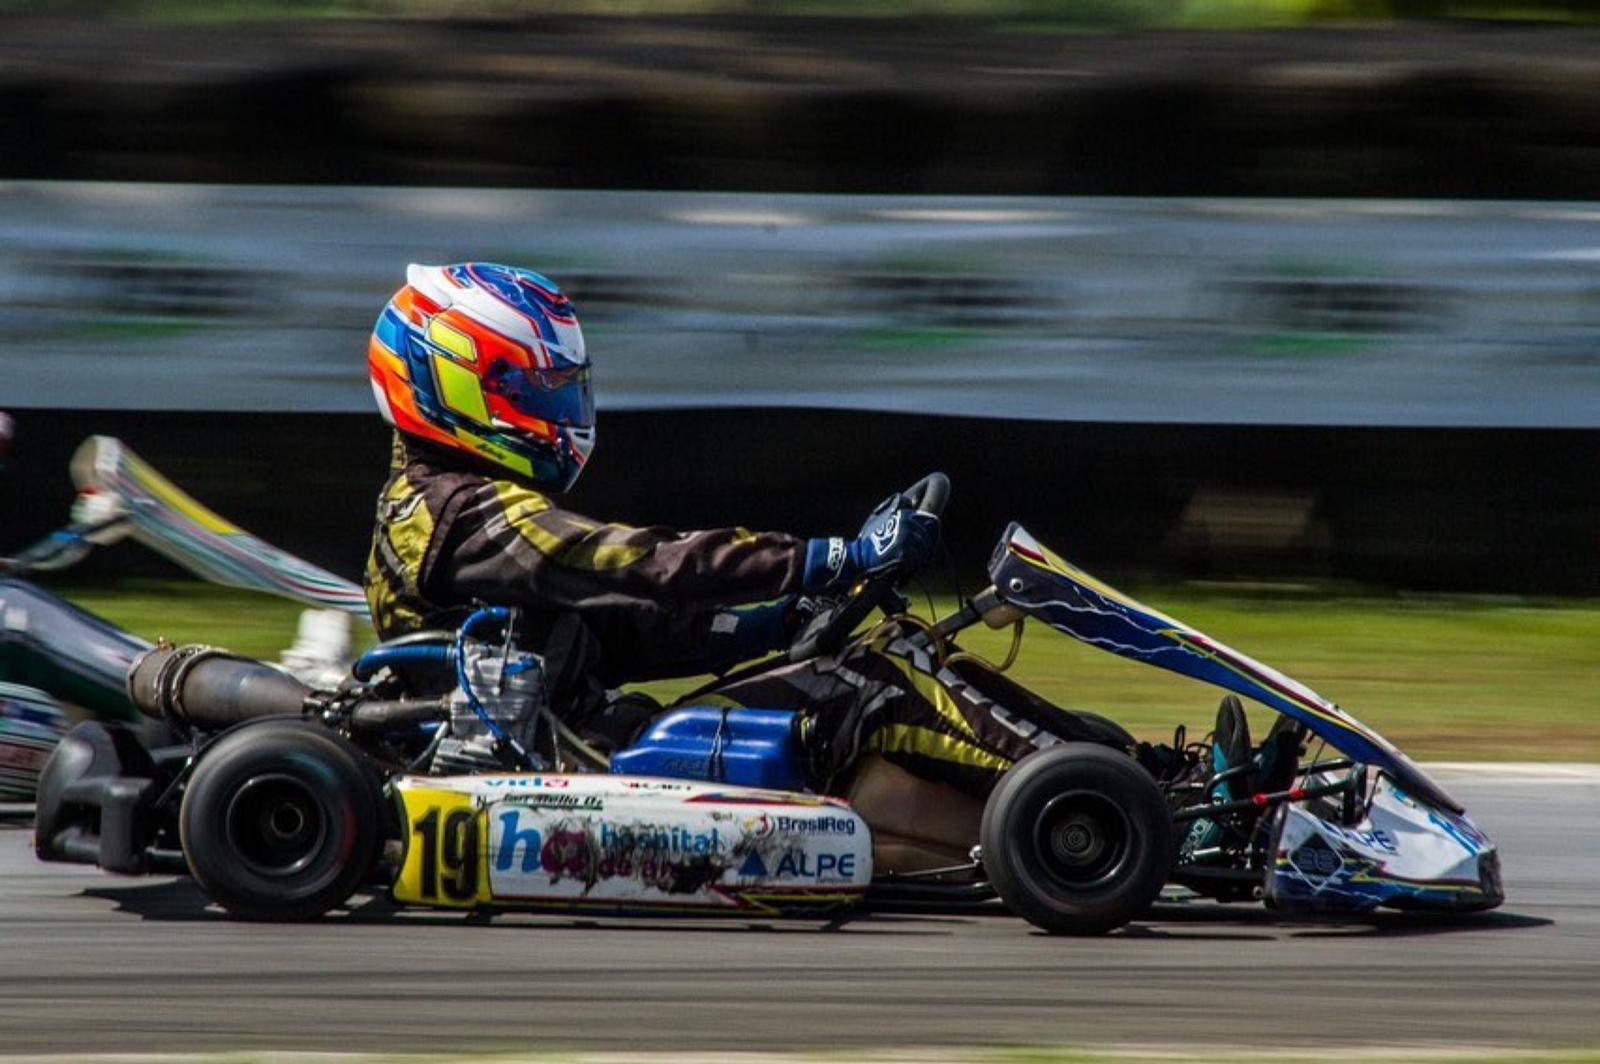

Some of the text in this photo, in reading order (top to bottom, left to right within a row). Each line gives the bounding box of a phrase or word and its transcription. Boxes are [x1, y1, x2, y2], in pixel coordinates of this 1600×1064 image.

[777, 816, 856, 836] BrasilReg
[412, 806, 478, 900] 19
[775, 850, 856, 877] ALPE
